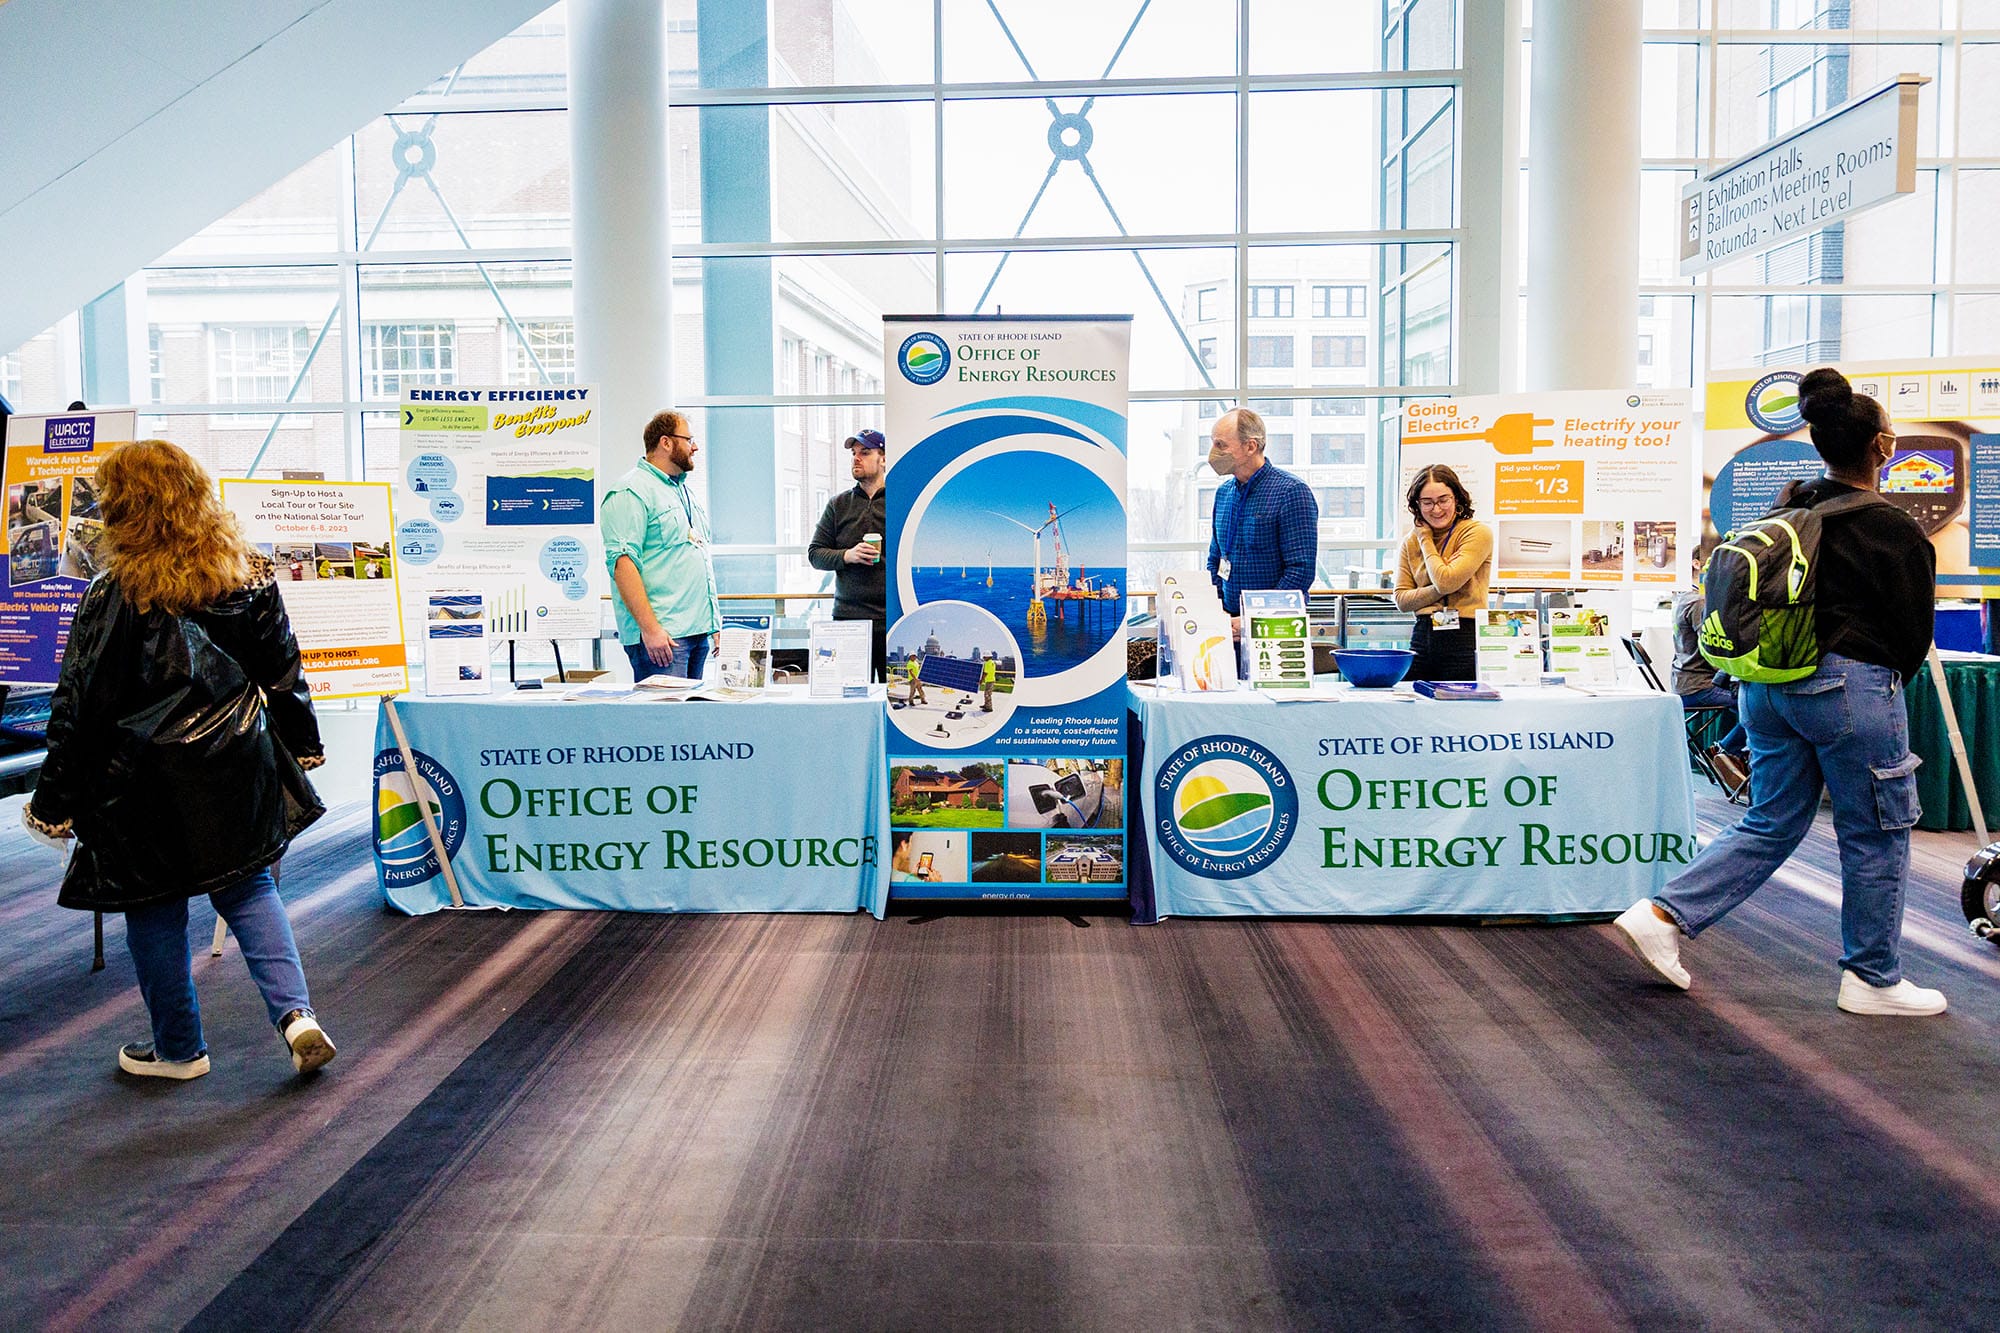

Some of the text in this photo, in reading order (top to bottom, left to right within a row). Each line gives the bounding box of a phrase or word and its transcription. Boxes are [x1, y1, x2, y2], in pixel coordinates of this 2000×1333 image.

[1707, 137, 1893, 234] Ballrooms Meeting Rooms
[1708, 146, 1803, 211] Exhibition Halls
[1706, 224, 1757, 261] Rotunda
[1773, 206, 1806, 236] Next
[1812, 180, 1852, 221] Level
[958, 333, 1062, 341] STATE OF RHODE ISLAND
[957, 345, 1041, 361] OFFICE OF
[958, 366, 1116, 382] ENERGY RESOURCES
[410, 389, 589, 402] ENERGY EFFICIENCY
[492, 405, 558, 430] Benefits
[1408, 403, 1458, 419] Going
[55, 422, 91, 437] WACTC
[514, 409, 591, 439] Everyone!
[1408, 416, 1480, 433] Electric?
[1564, 418, 1680, 434] Electrify your
[52, 437, 90, 446] ELECTRICITY
[1564, 434, 1671, 450] heating too!
[26, 454, 101, 466] Warwick Area Care
[30, 467, 36, 476] &
[37, 466, 74, 475] Technical
[271, 489, 306, 499] Sign-Up
[307, 490, 316, 498] to
[317, 490, 336, 498] Host
[1535, 478, 1569, 494] 1/3
[262, 501, 285, 509] Local
[287, 501, 306, 509] Tour
[318, 501, 337, 509] Tour
[338, 502, 355, 510] Site
[267, 513, 282, 521] the
[284, 513, 318, 521] National
[320, 513, 342, 521] Solar
[274, 524, 309, 532] October
[328, 525, 349, 533] 2023
[0, 602, 79, 612] Electric Vehicle FAC
[310, 652, 321, 660] UP
[323, 651, 334, 659] TO
[336, 650, 360, 658] HOST:
[303, 658, 379, 669] ALSOLARTOUR.ORG
[309, 682, 331, 693] OUR
[1030, 717, 1119, 726] Leading Rhode Island
[1014, 727, 1023, 735] to
[1064, 727, 1119, 735] cost-effective
[995, 737, 1118, 747] and sustainable energy future.
[1319, 731, 1615, 756] STATE OF RHODE ISLAND
[480, 742, 754, 767] STATE OF RHODE ISLAND
[1159, 741, 1286, 791] STATE OF RHODE ISLAND
[420, 760, 454, 796] ISLAND
[1317, 768, 1557, 811] OFFICE OF
[480, 778, 698, 819] OFFICE OF
[1160, 812, 1290, 872] OFFICE OF ENERGY RESOURCES
[1319, 827, 1507, 869] ENERGY
[483, 833, 650, 873] ENERGY
[385, 865, 426, 880] ENERGY
